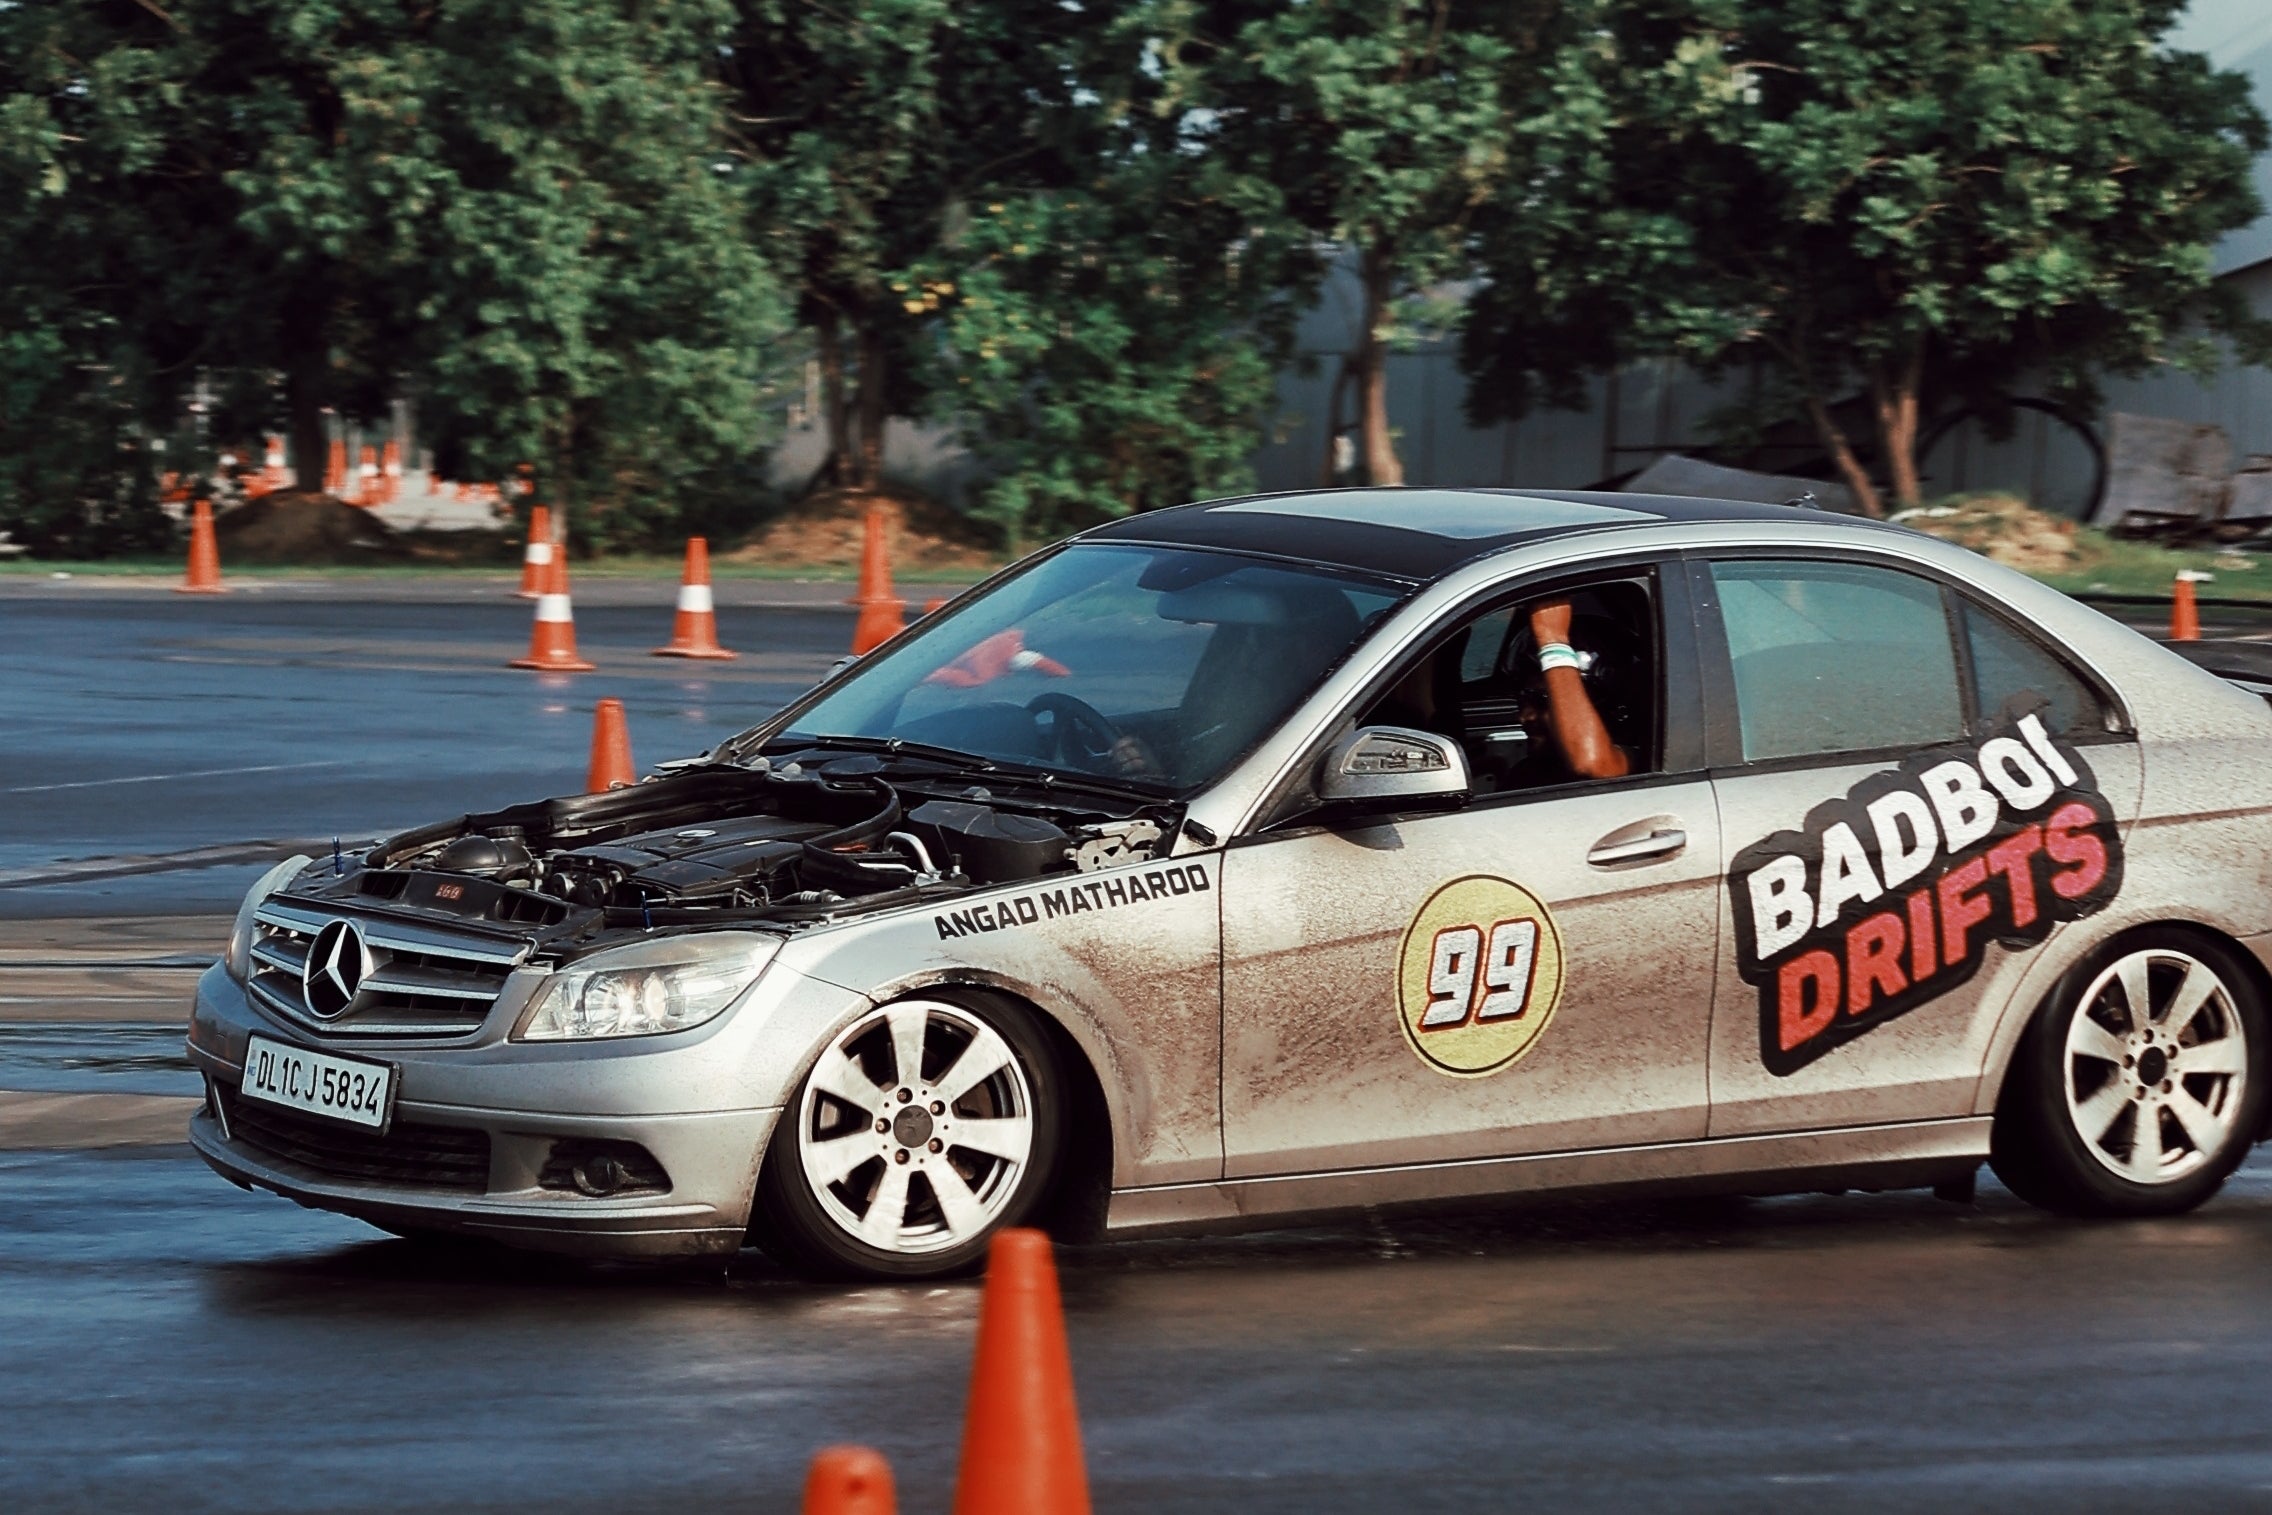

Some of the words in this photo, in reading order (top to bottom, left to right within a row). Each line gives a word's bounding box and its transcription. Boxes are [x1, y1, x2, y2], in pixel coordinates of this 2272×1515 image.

[1747, 713, 2079, 961] BADBOI
[934, 896, 1039, 940] ANGAD
[1039, 864, 1210, 919] MATHAROO
[1777, 802, 2108, 1052] DRIFTS
[1417, 917, 1541, 1034] 99
[321, 1067, 381, 1116] 5834
